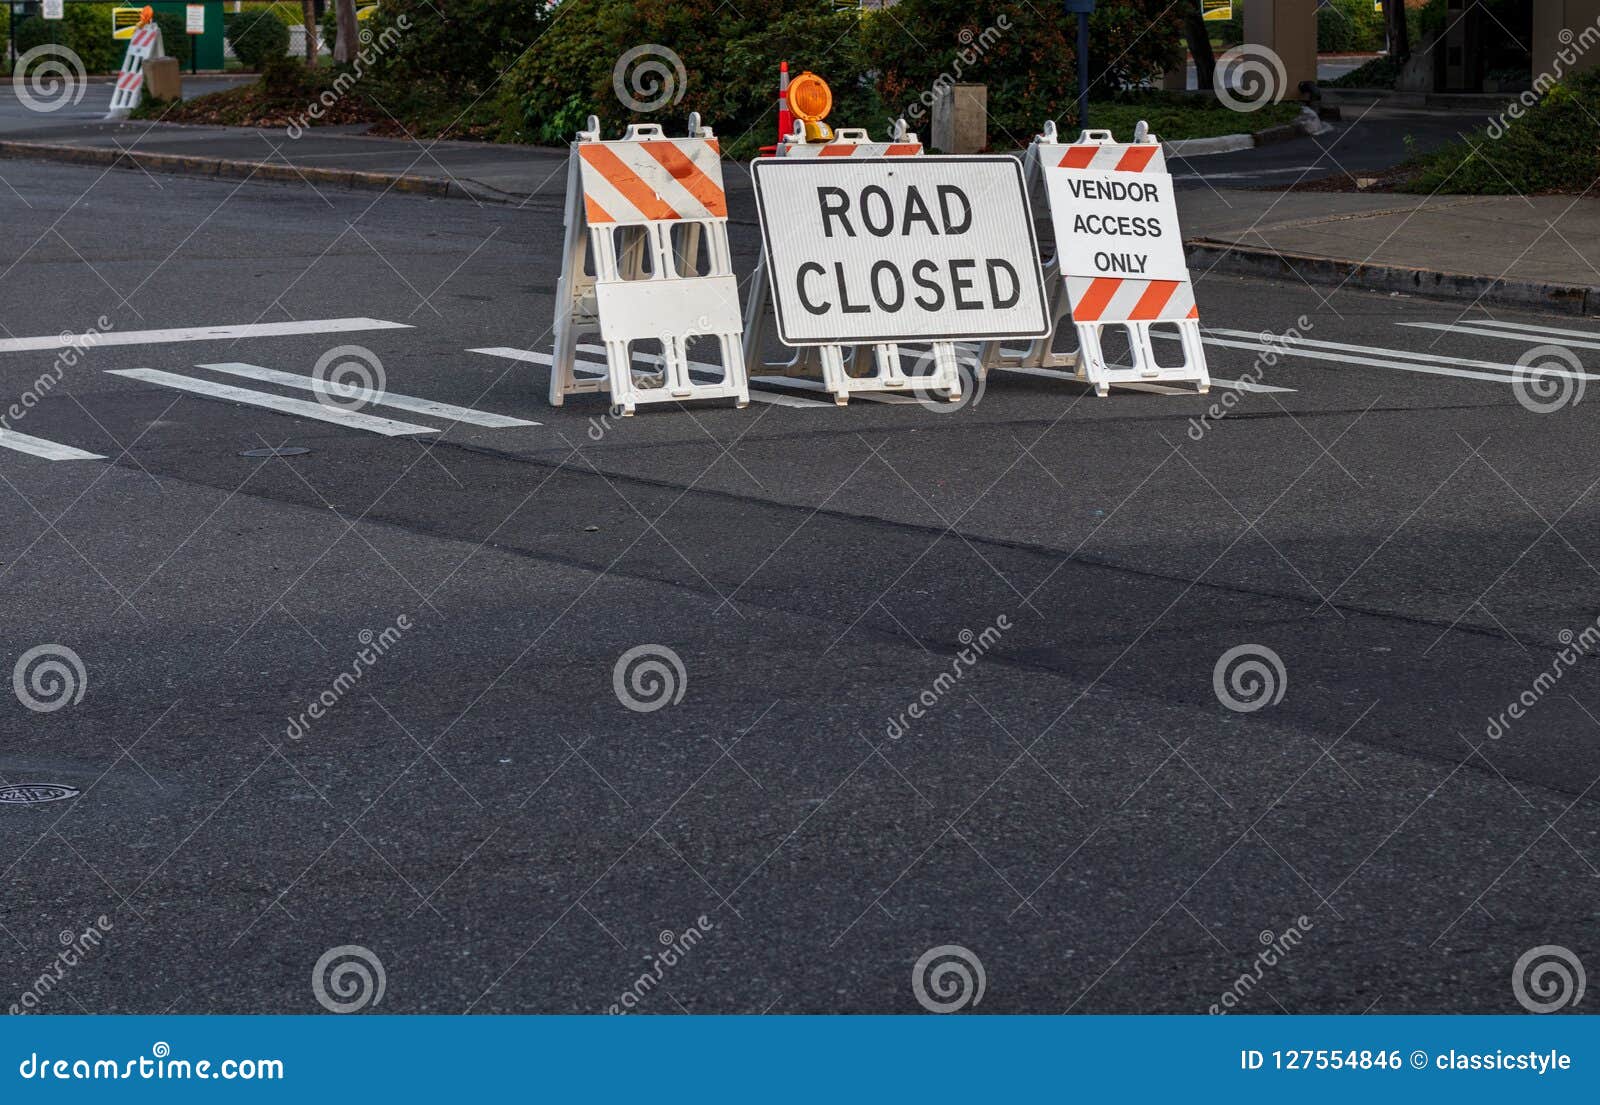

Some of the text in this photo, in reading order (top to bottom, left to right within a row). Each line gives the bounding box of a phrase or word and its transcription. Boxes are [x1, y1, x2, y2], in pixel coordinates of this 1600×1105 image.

[1067, 178, 1160, 203] VENDOR
[816, 184, 973, 238] ROAD
[1073, 214, 1162, 238] ACCESS
[1094, 251, 1148, 274] ONLY
[796, 258, 1021, 316] CLOSED
